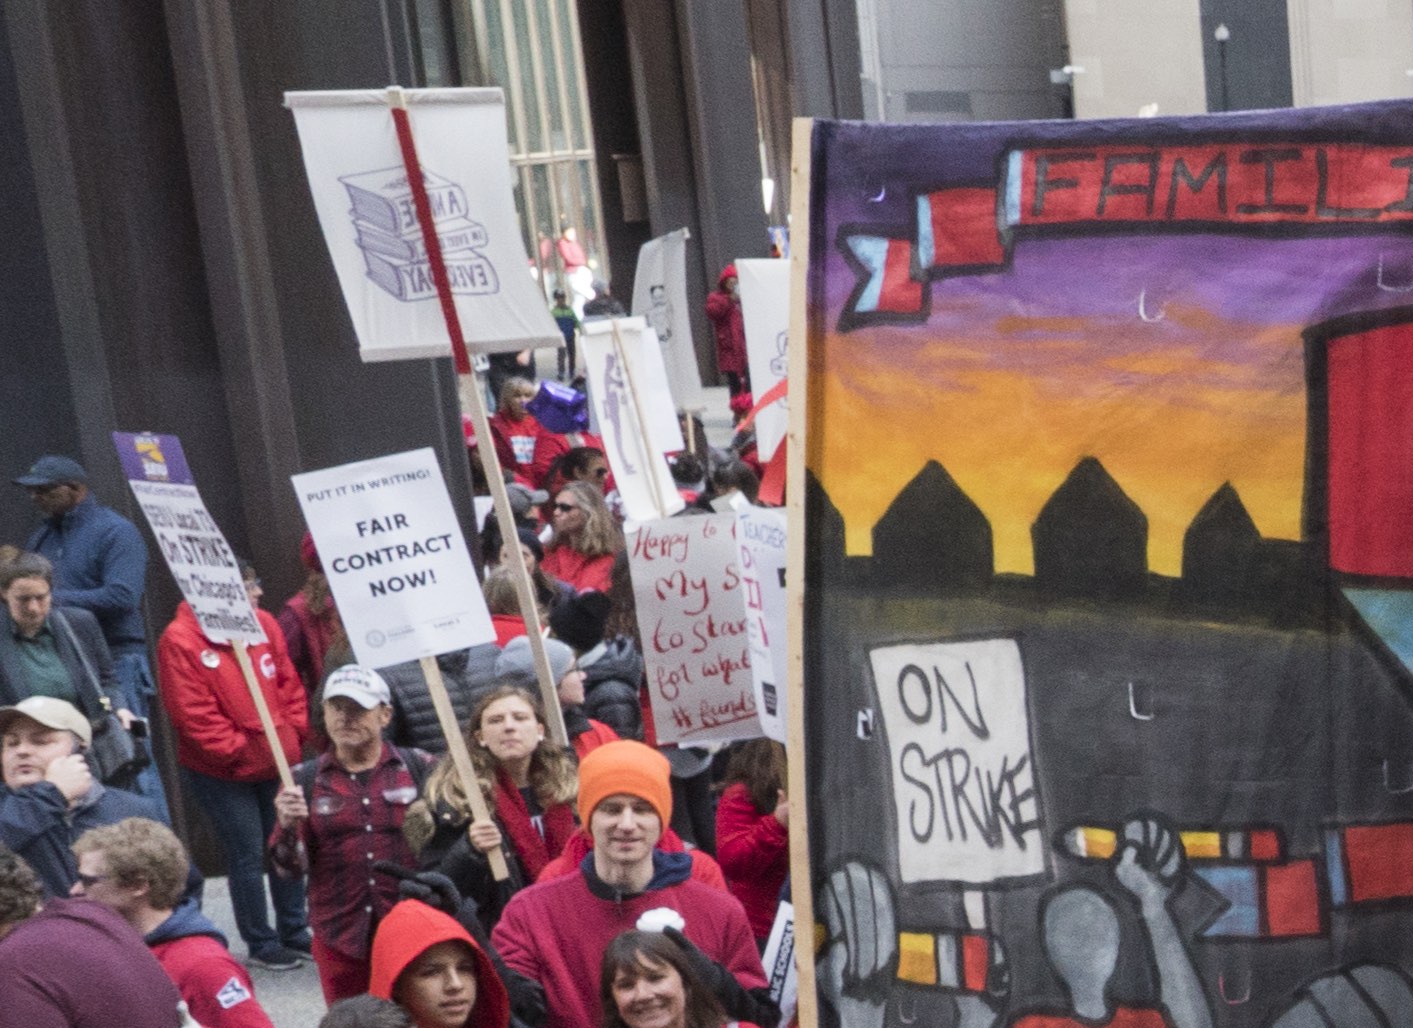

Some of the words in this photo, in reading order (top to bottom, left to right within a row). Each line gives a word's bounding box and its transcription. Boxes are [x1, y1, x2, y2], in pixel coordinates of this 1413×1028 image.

[307, 489, 333, 503] PUT
[336, 486, 348, 498] IT
[352, 482, 365, 495] IN
[368, 468, 431, 490] WRITING!
[355, 513, 410, 537] FAIR
[332, 533, 453, 574] CONTRACT
[632, 527, 689, 562] Happy
[369, 568, 437, 598] NOW!
[656, 570, 709, 616] My
[897, 660, 990, 741] ON
[900, 742, 1046, 852] STRIKE
